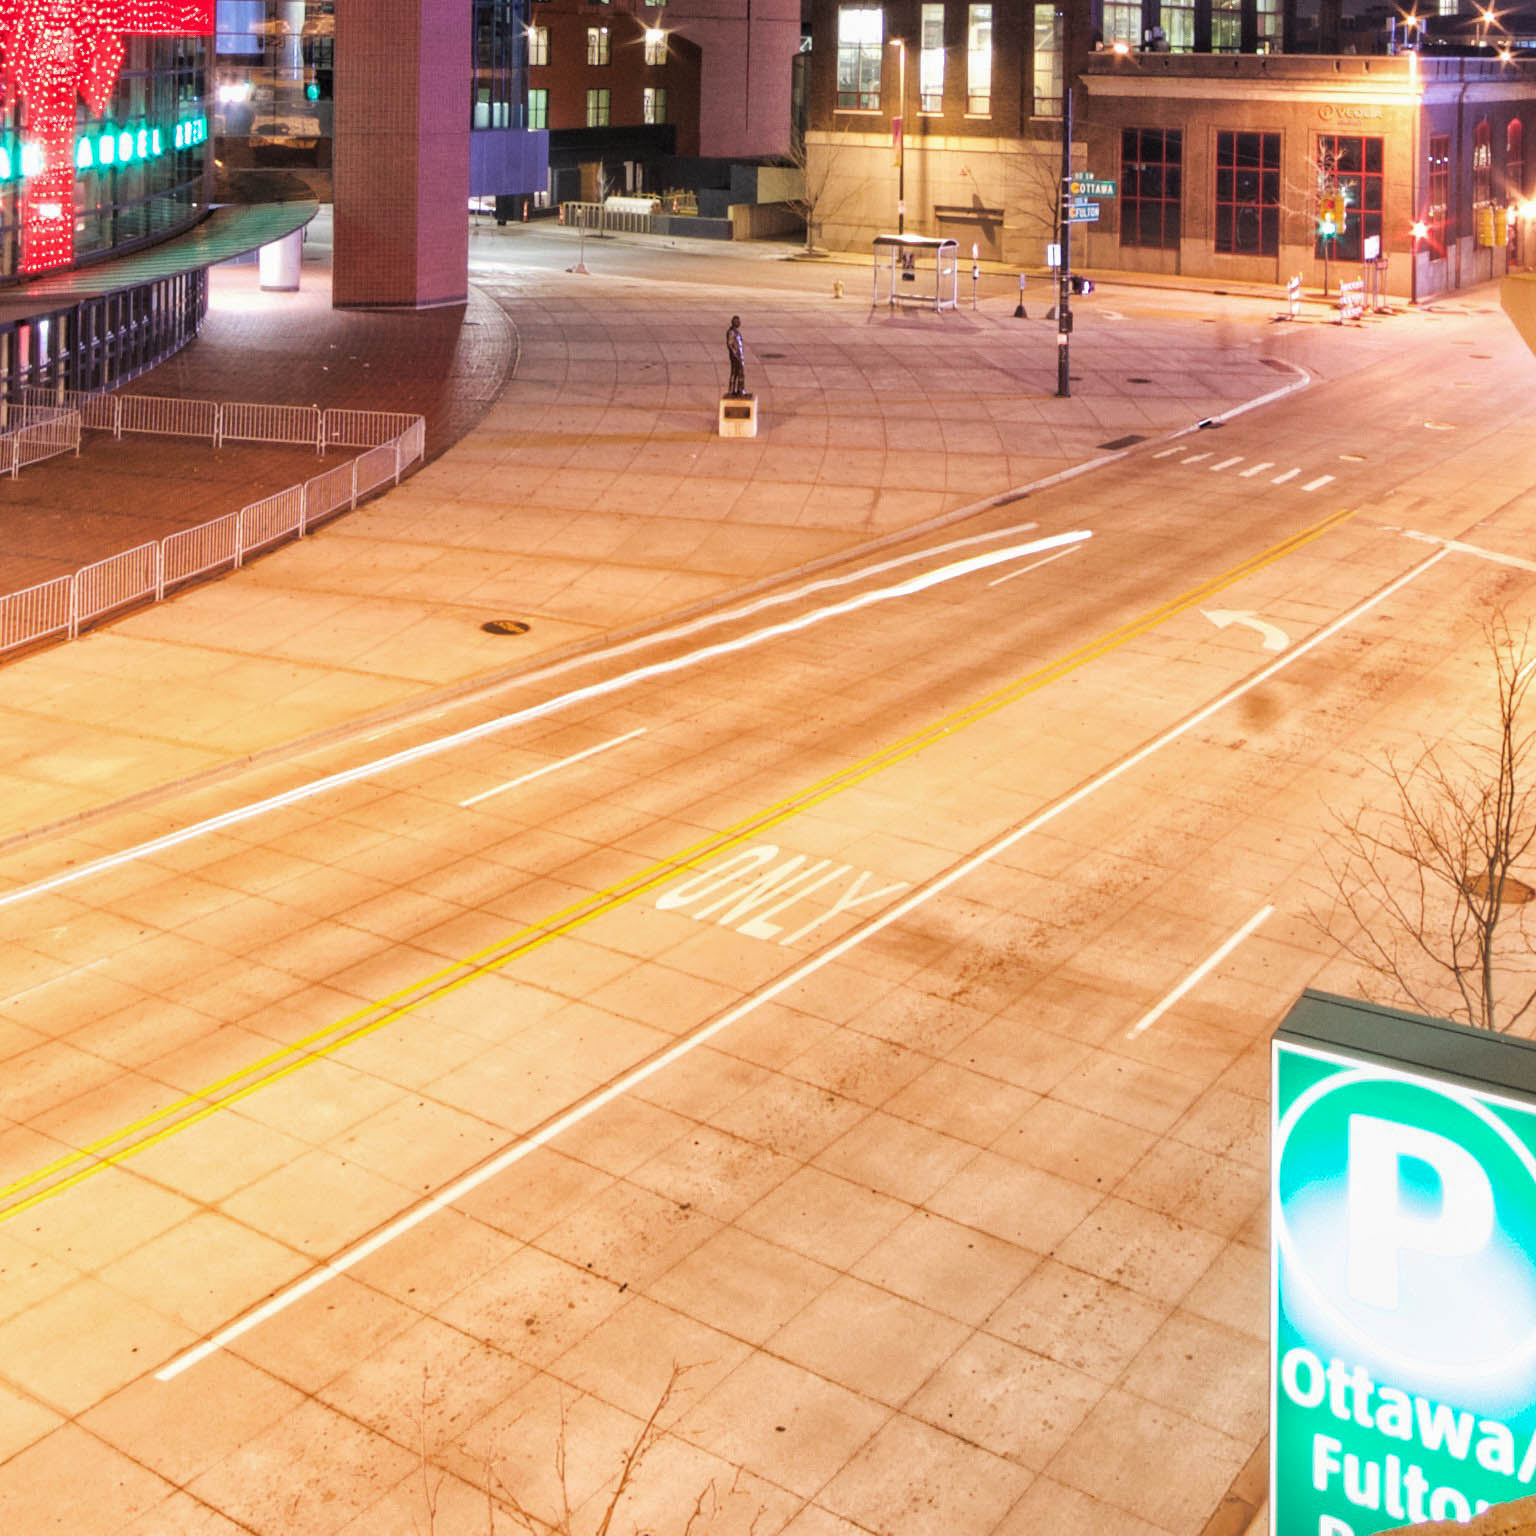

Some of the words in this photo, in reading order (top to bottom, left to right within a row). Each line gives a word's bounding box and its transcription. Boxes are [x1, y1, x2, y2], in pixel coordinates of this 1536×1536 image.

[1079, 183, 1114, 194] OTTAWA
[655, 844, 911, 945] ONLY
[1348, 1113, 1495, 1310] P
